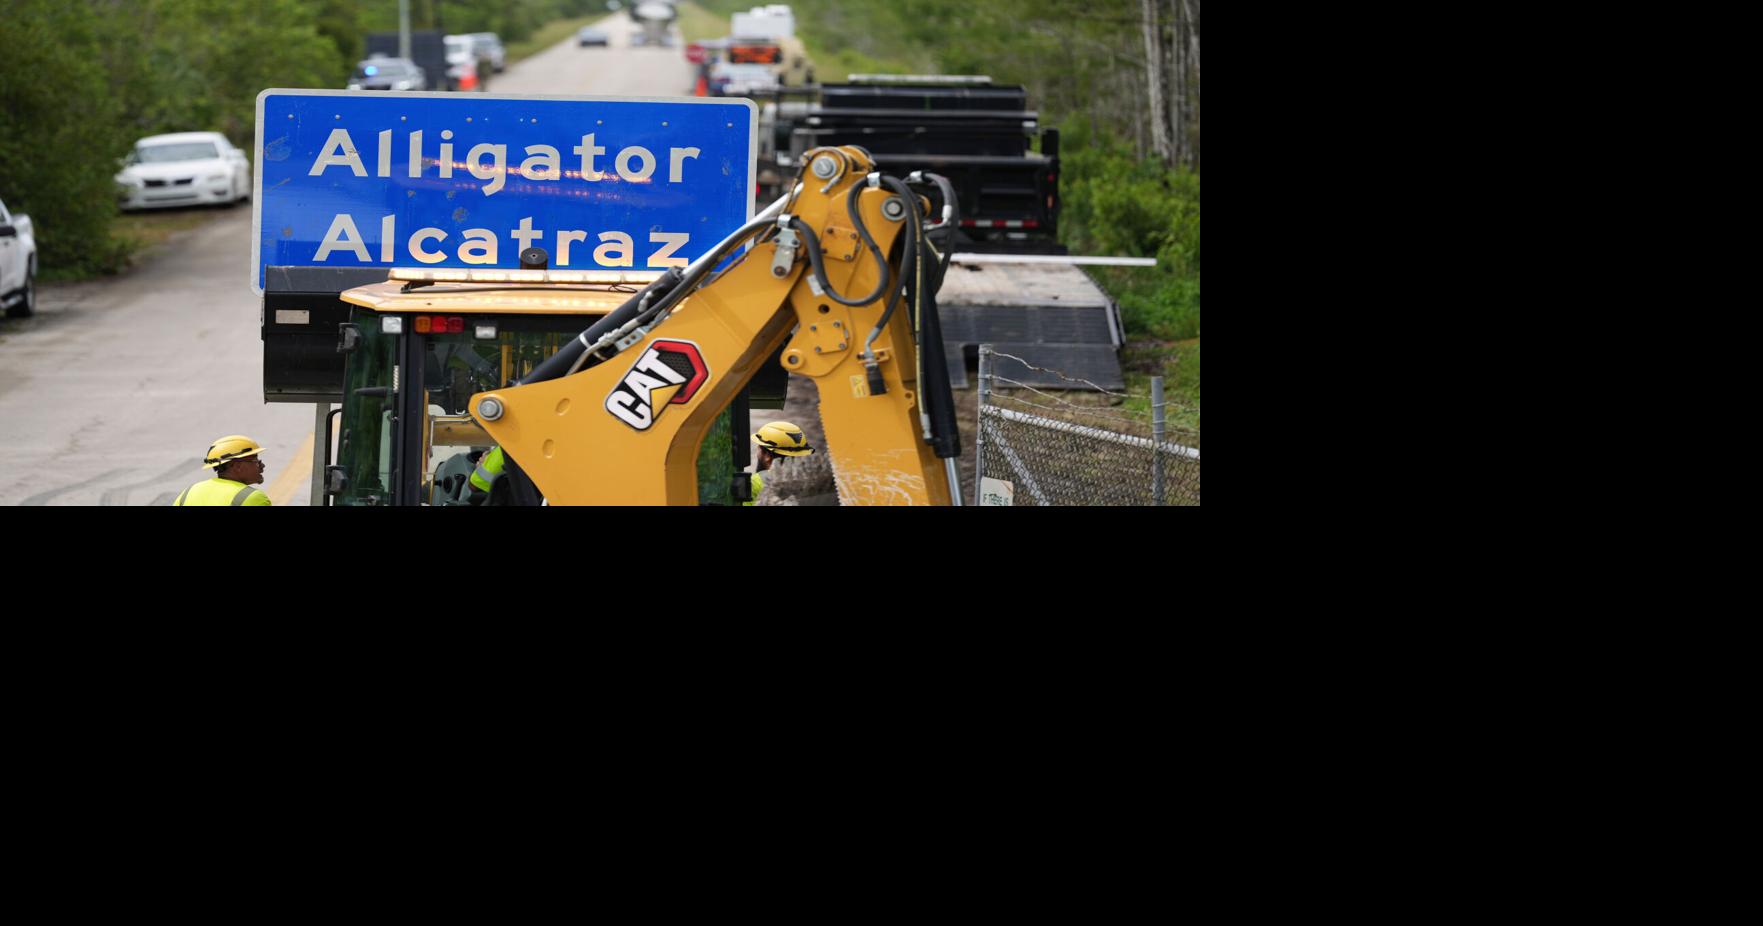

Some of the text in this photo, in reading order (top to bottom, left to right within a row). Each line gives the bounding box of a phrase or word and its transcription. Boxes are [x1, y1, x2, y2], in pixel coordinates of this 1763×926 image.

[308, 128, 701, 197] Alligator
[312, 213, 690, 268] Alcatraz
[606, 348, 687, 430] CAT
